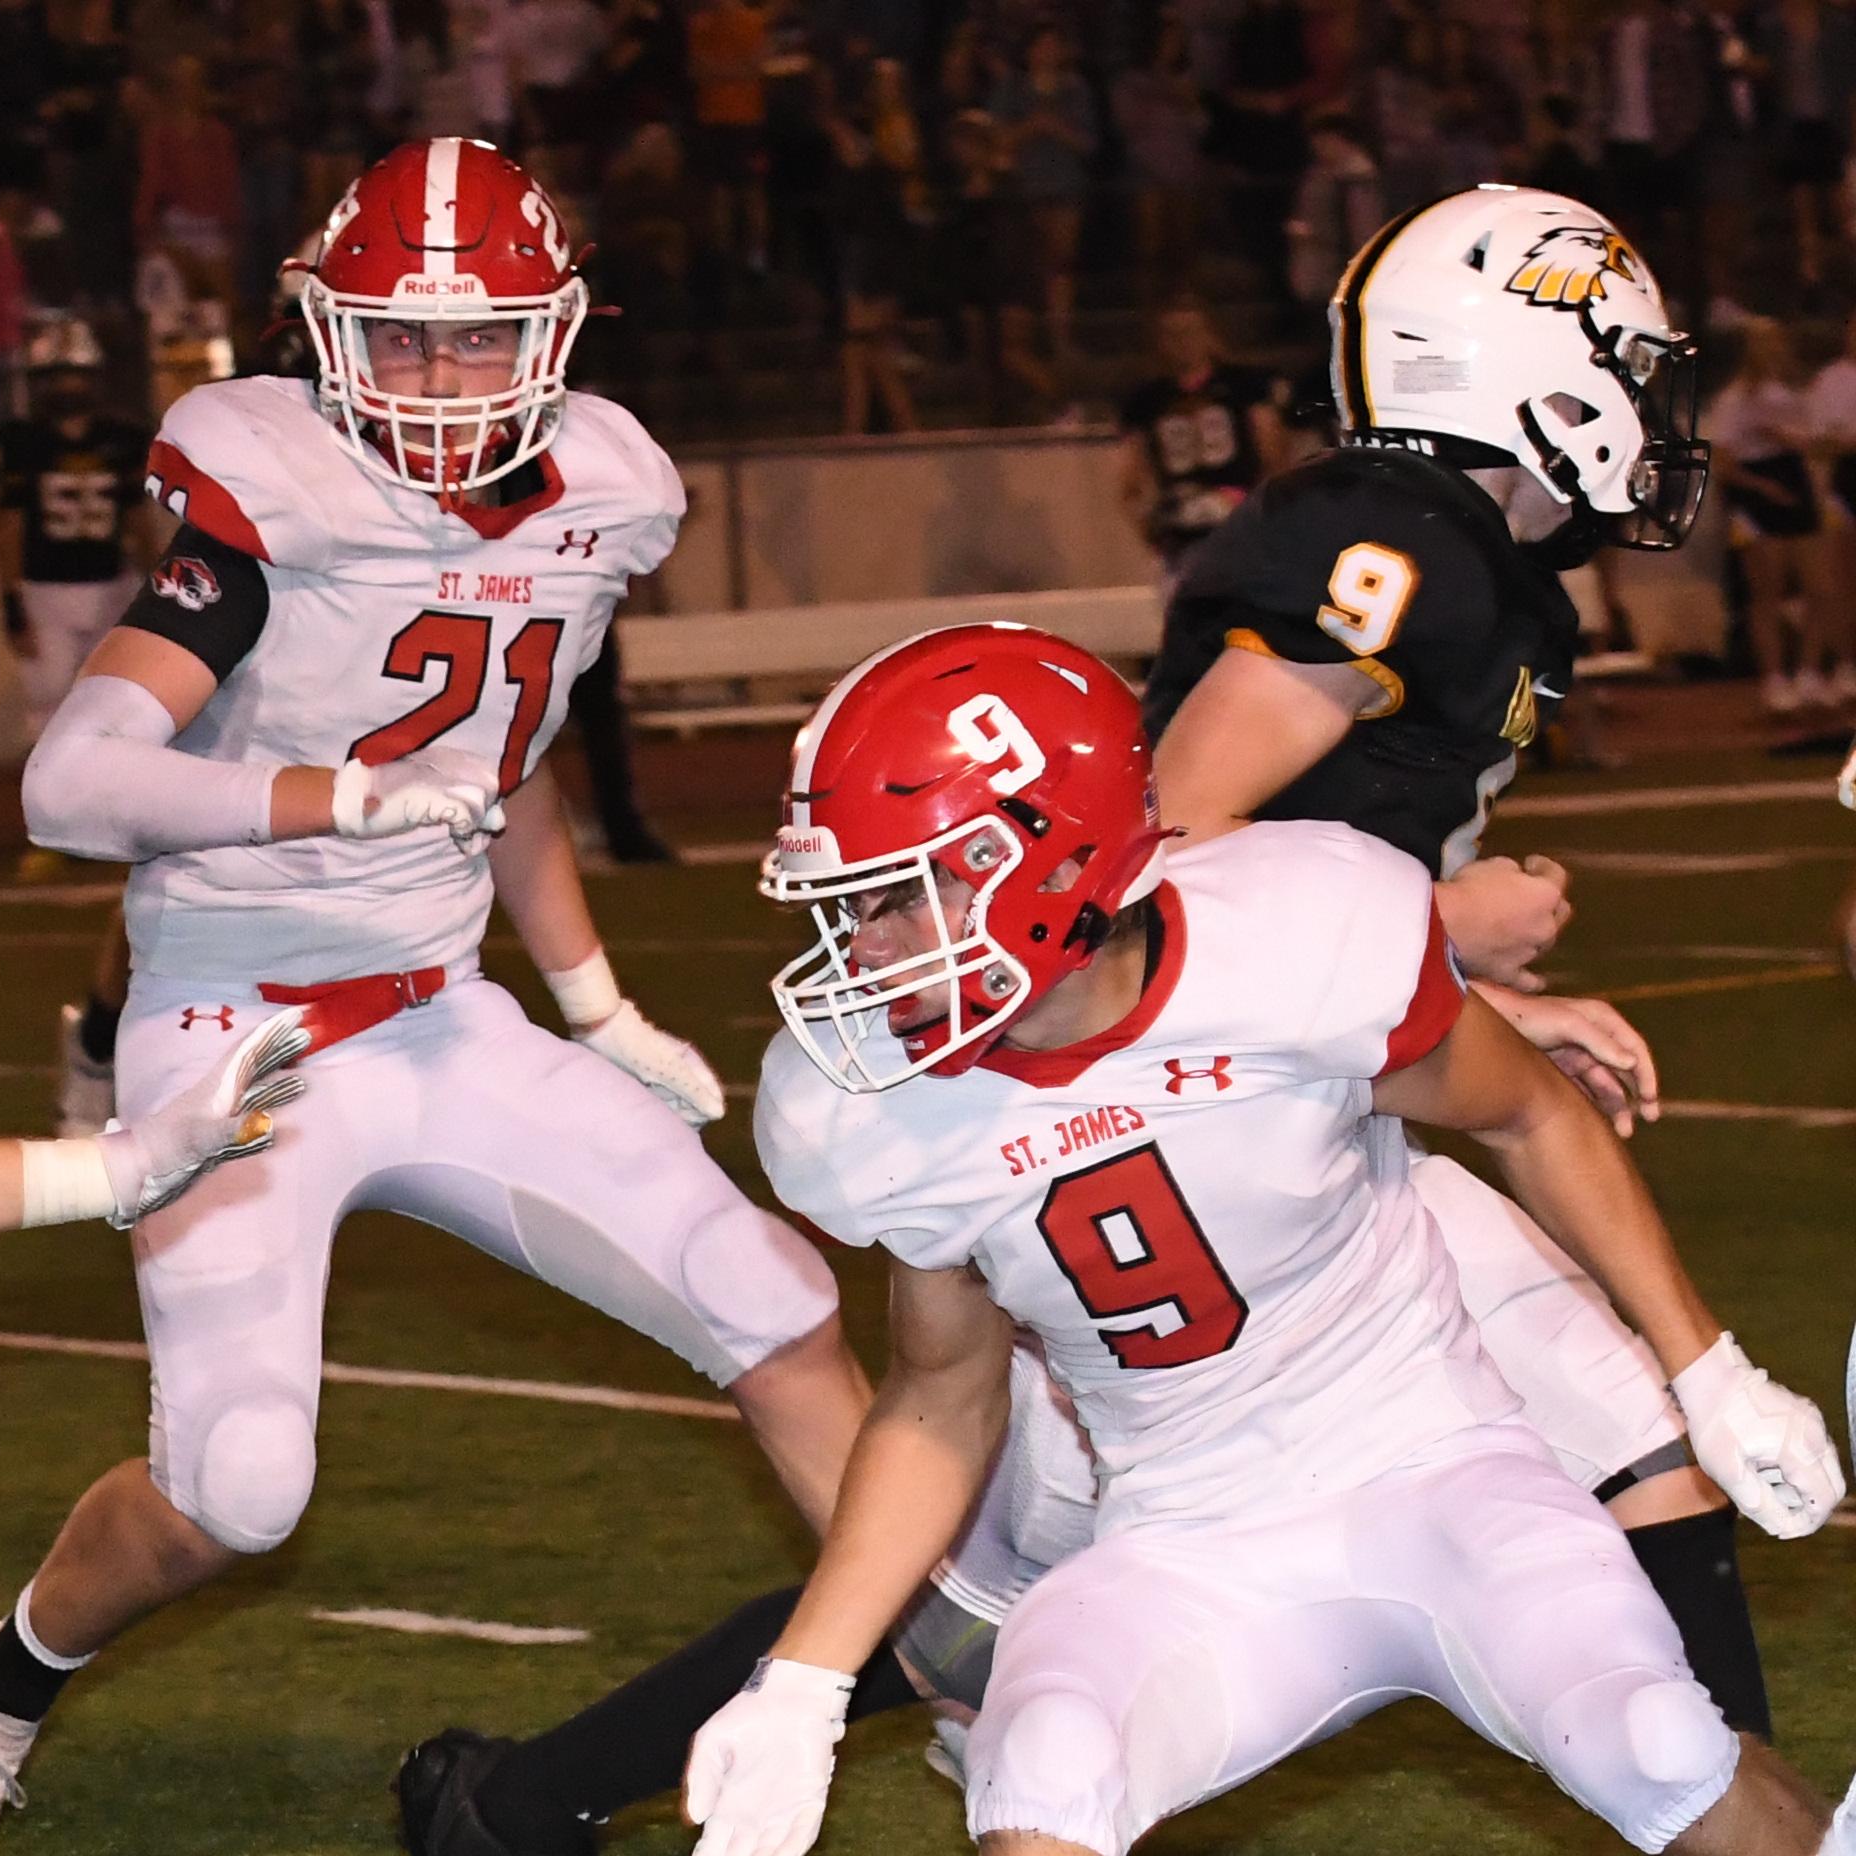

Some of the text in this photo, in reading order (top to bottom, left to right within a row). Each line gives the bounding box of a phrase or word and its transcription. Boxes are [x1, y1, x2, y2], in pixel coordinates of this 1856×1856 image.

[437, 571, 534, 604] ST. JAMES
[1315, 541, 1423, 657] 9
[344, 609, 566, 797] 21
[947, 693, 1046, 796] 9
[999, 1105, 1147, 1177] ST. JAMES
[1035, 1140, 1250, 1371] 9
